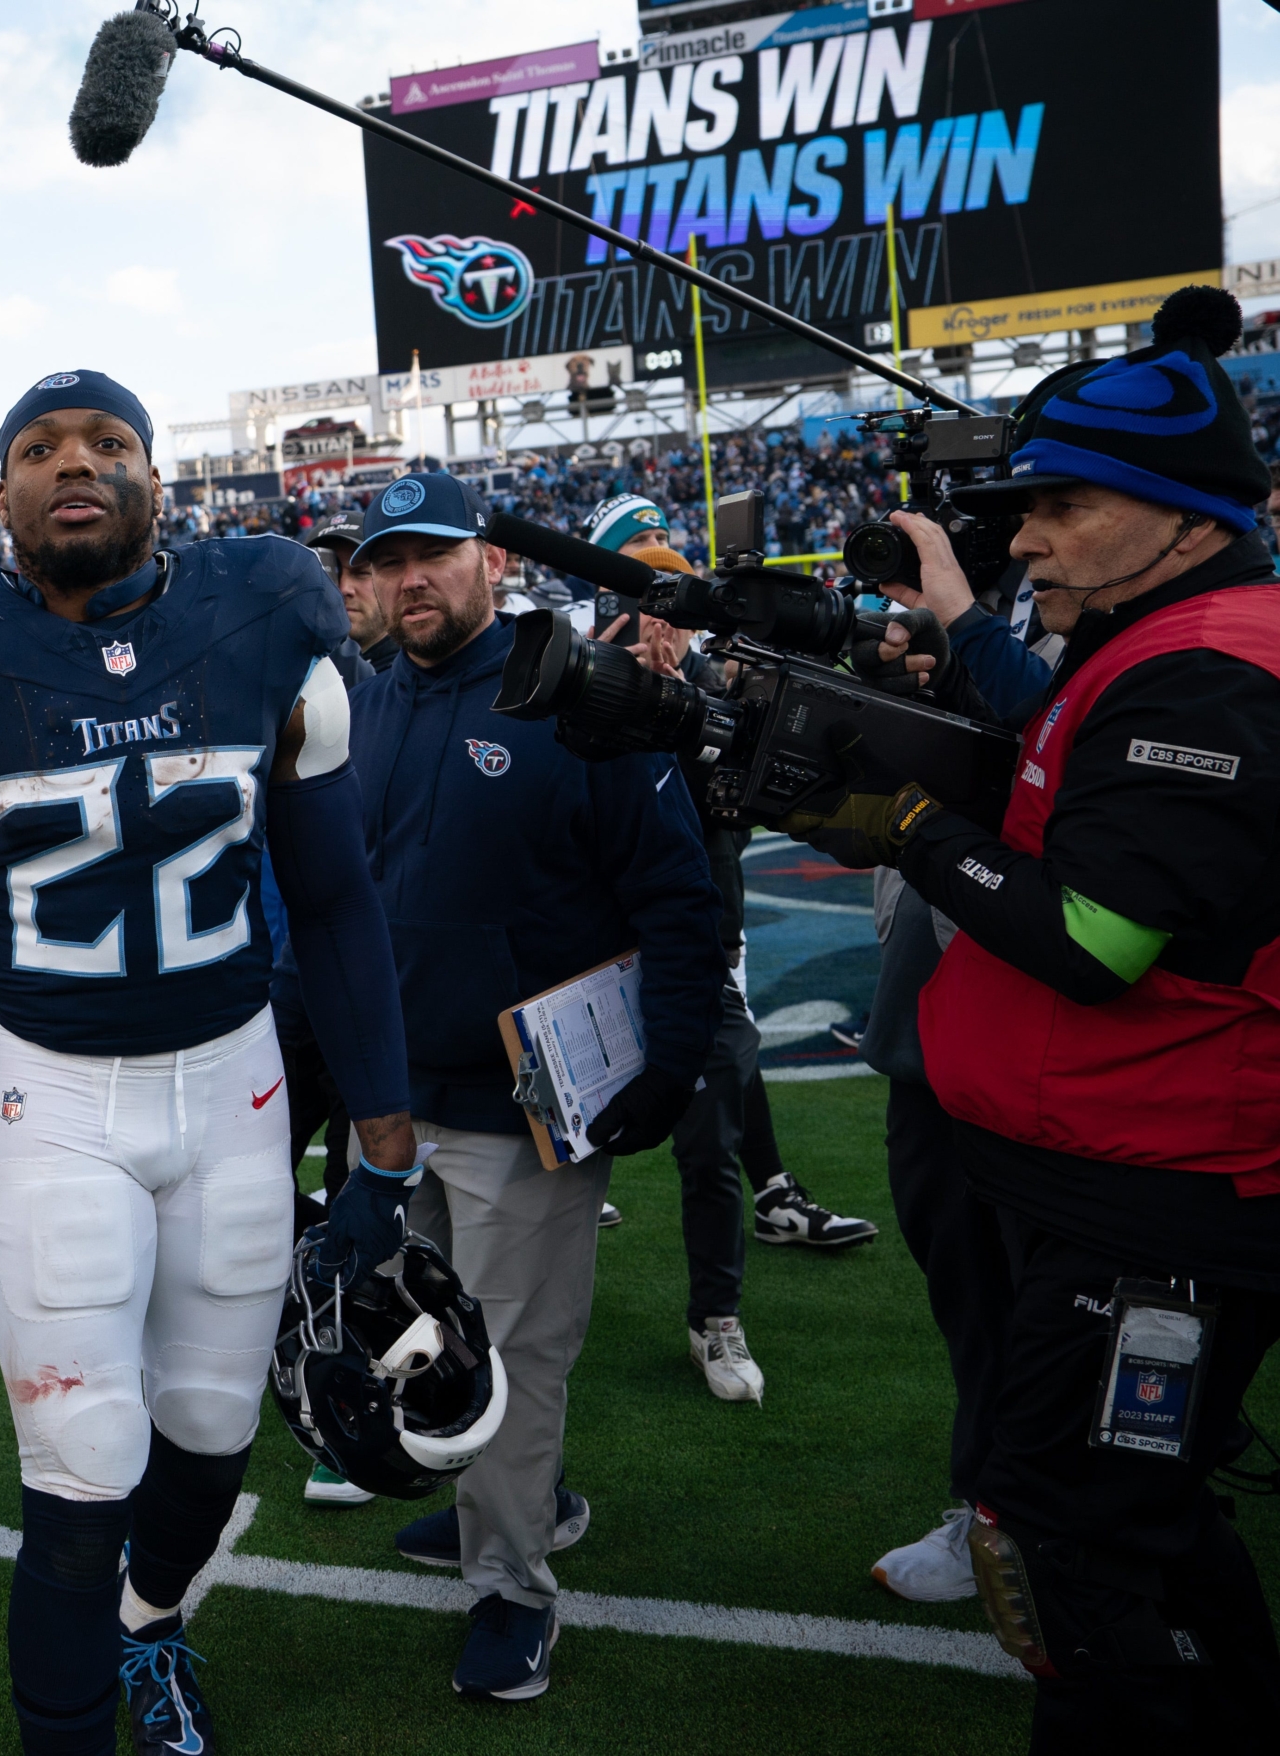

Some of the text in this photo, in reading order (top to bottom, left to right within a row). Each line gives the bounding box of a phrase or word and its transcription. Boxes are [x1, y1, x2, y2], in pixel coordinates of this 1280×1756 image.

[642, 30, 746, 66] Pinnacle
[430, 60, 576, 96] Ascension Saint Thomas
[489, 20, 933, 181] TITANS WIN
[585, 102, 1045, 265] TITANS WIN
[1017, 293, 1173, 322] FRESH FOR EVERYON
[943, 306, 1009, 338] Kroger
[249, 377, 367, 405] NISSAN
[317, 523, 360, 537] FILMS
[108, 654, 132, 671] NFL
[72, 701, 181, 756] TITANS
[1150, 747, 1232, 774] CBS SPORTS
[899, 798, 930, 831] FIRM GRIP
[1072, 892, 1099, 913] Access
[542, 1031, 552, 1052] TITANS
[551, 1040, 559, 1057] January
[549, 1052, 564, 1088] TENNESSEE
[4, 1102, 20, 1117] NFL
[1074, 1294, 1113, 1317] FILA
[1132, 1357, 1181, 1369] CBS SPORTS NFL
[1140, 1382, 1161, 1396] NFL
[1118, 1409, 1176, 1424] 2023 STAFF
[1117, 1433, 1178, 1453] CBS SPORTS
